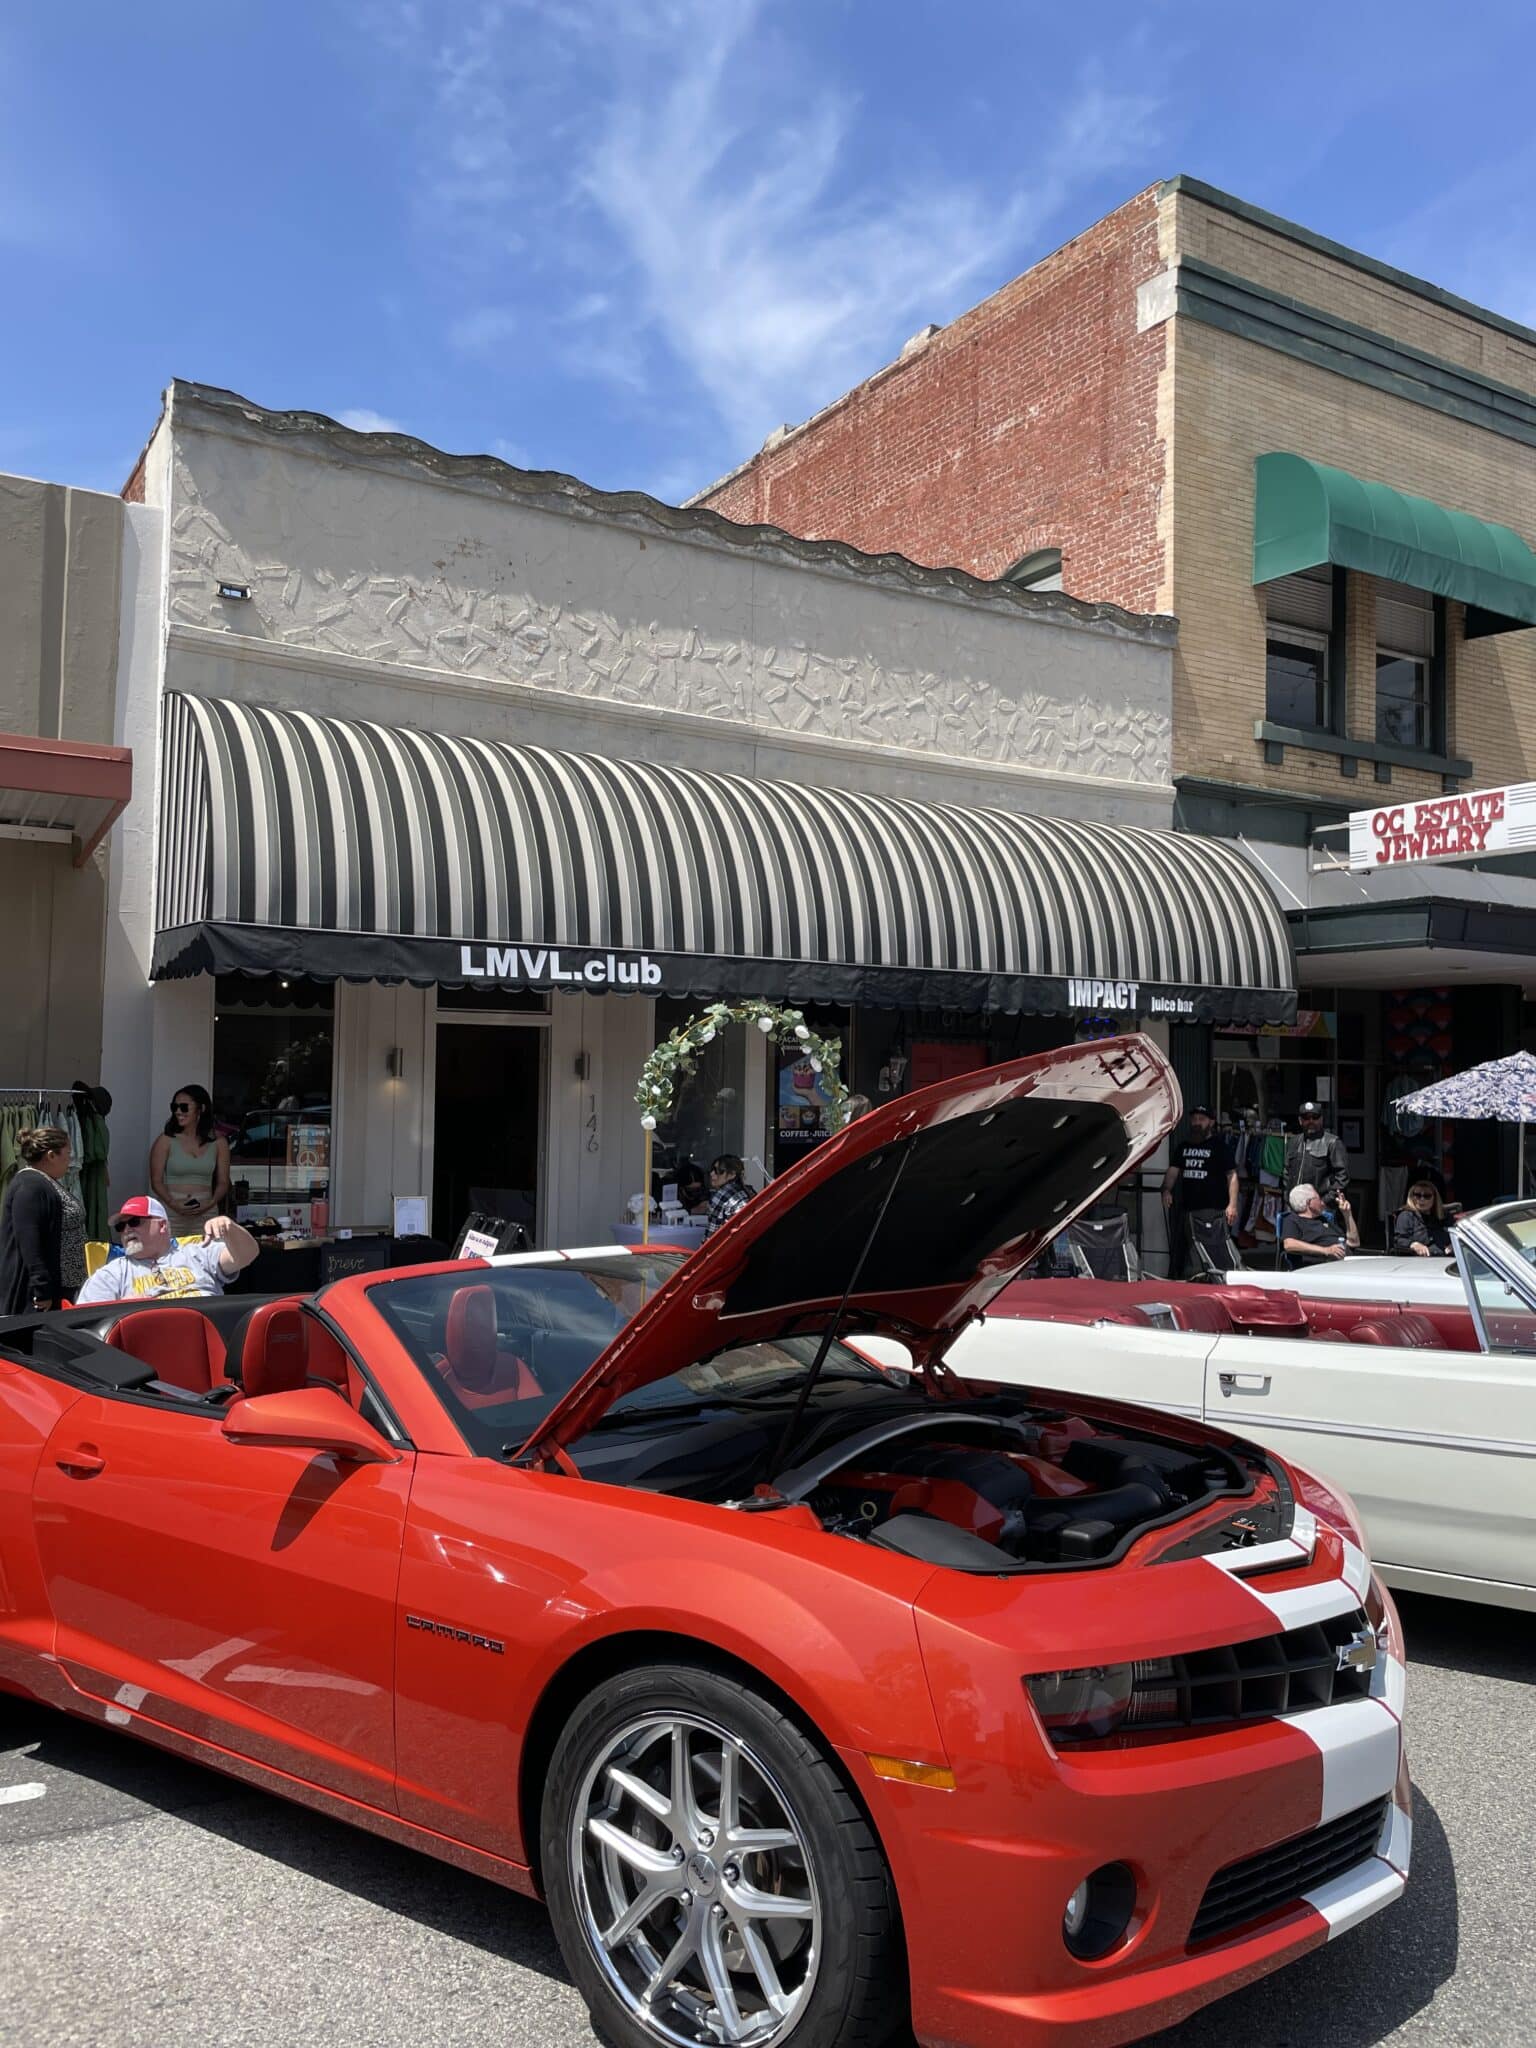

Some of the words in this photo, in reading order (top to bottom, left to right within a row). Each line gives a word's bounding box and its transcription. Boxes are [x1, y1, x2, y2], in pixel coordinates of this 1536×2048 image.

[1372, 808, 1404, 836] OC
[1414, 791, 1505, 831] ESTATE
[1376, 822, 1492, 863] JEWELRY
[460, 945, 662, 985] LMVL.club
[1068, 979, 1140, 1010] IMPACT
[1151, 996, 1176, 1013] juice
[1177, 998, 1194, 1013] bar
[1182, 1148, 1211, 1158] LIONS
